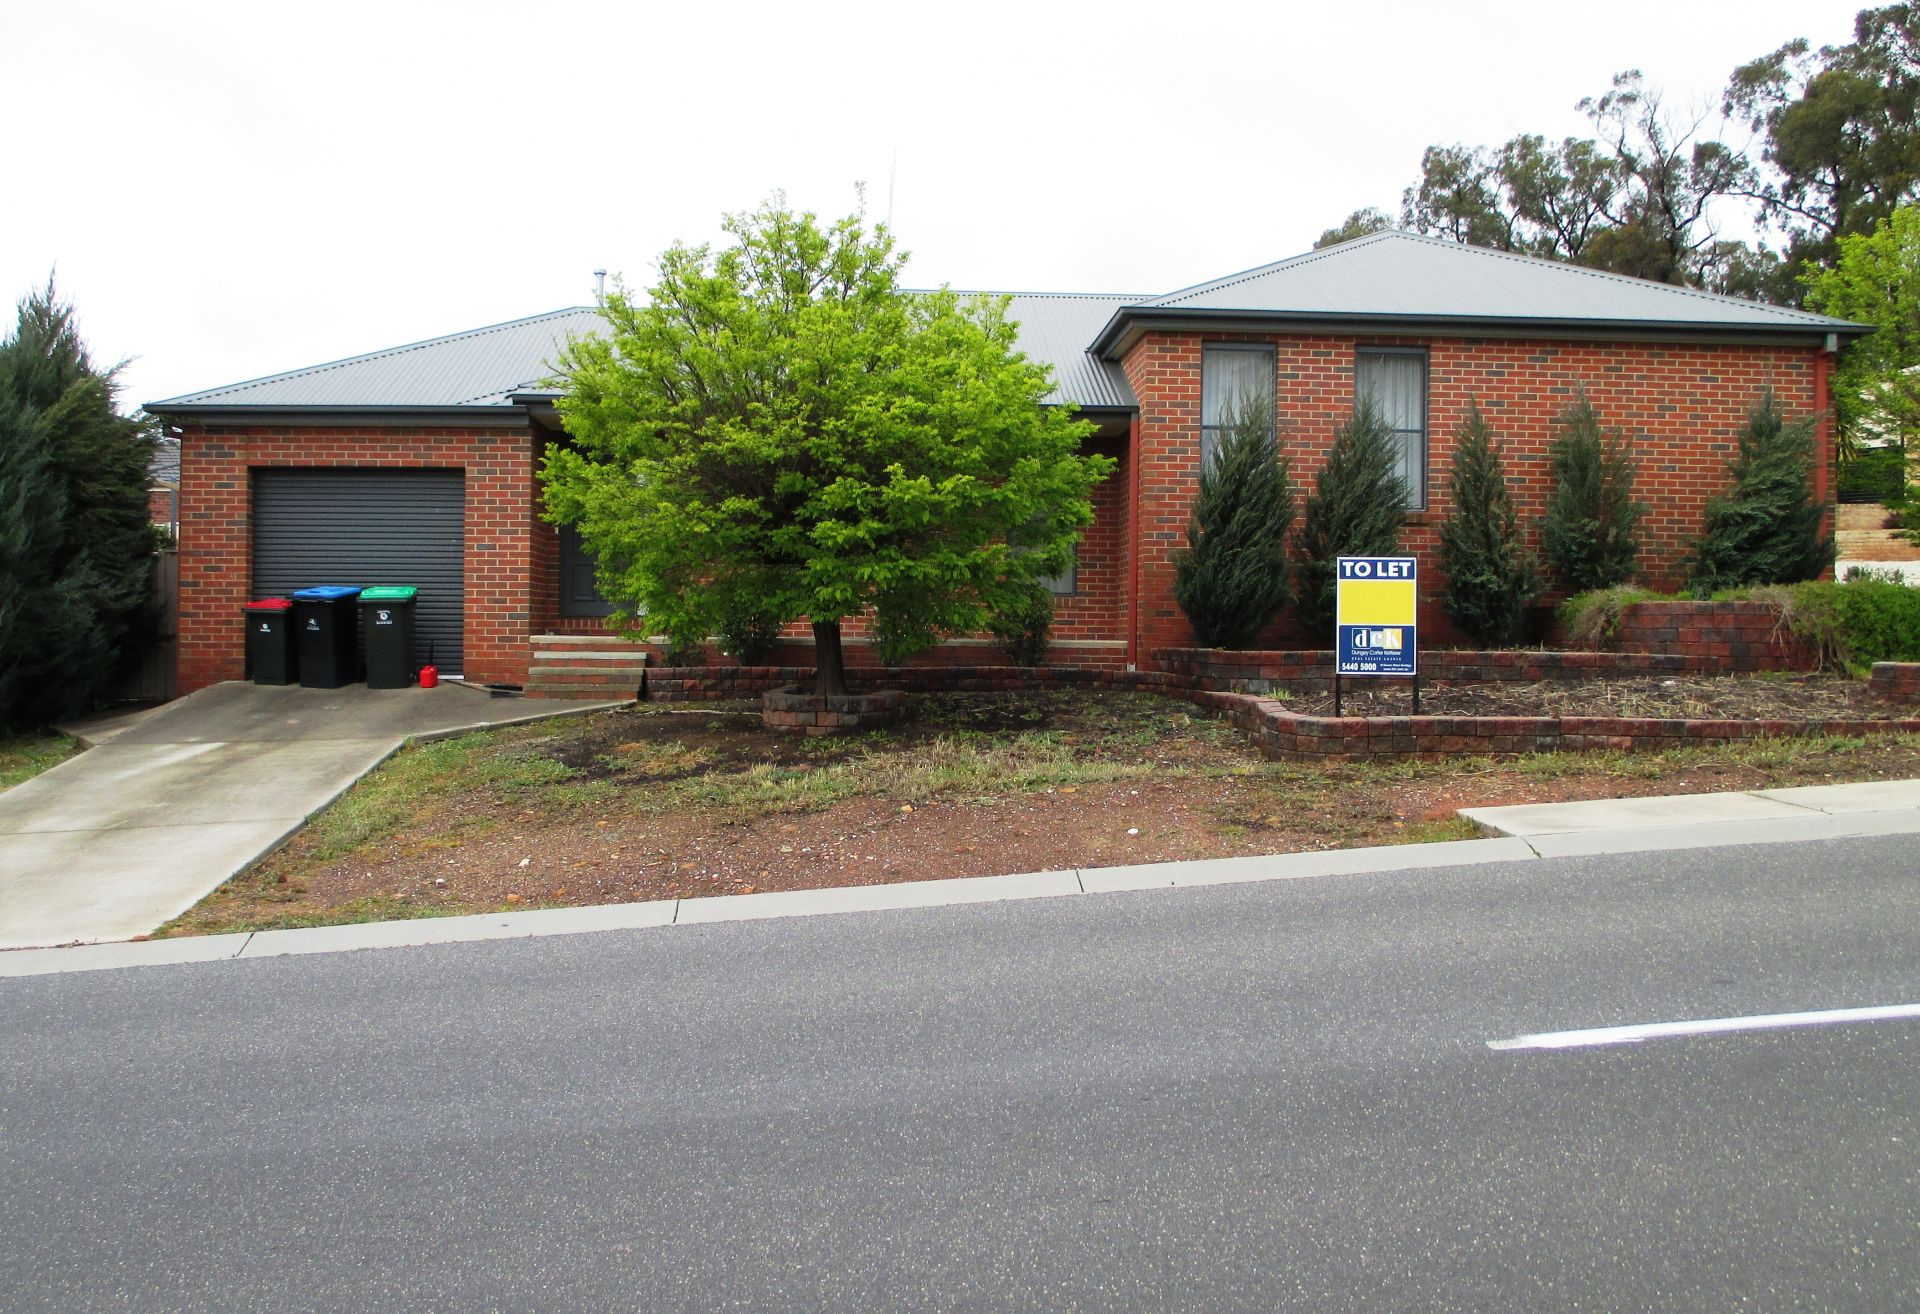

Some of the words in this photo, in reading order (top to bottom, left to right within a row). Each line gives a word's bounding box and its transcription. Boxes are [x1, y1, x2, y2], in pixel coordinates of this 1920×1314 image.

[1342, 561, 1372, 577] TO
[1376, 561, 1411, 577] LET
[1341, 662, 1359, 671] 5440
[1360, 662, 1377, 671] 5000
